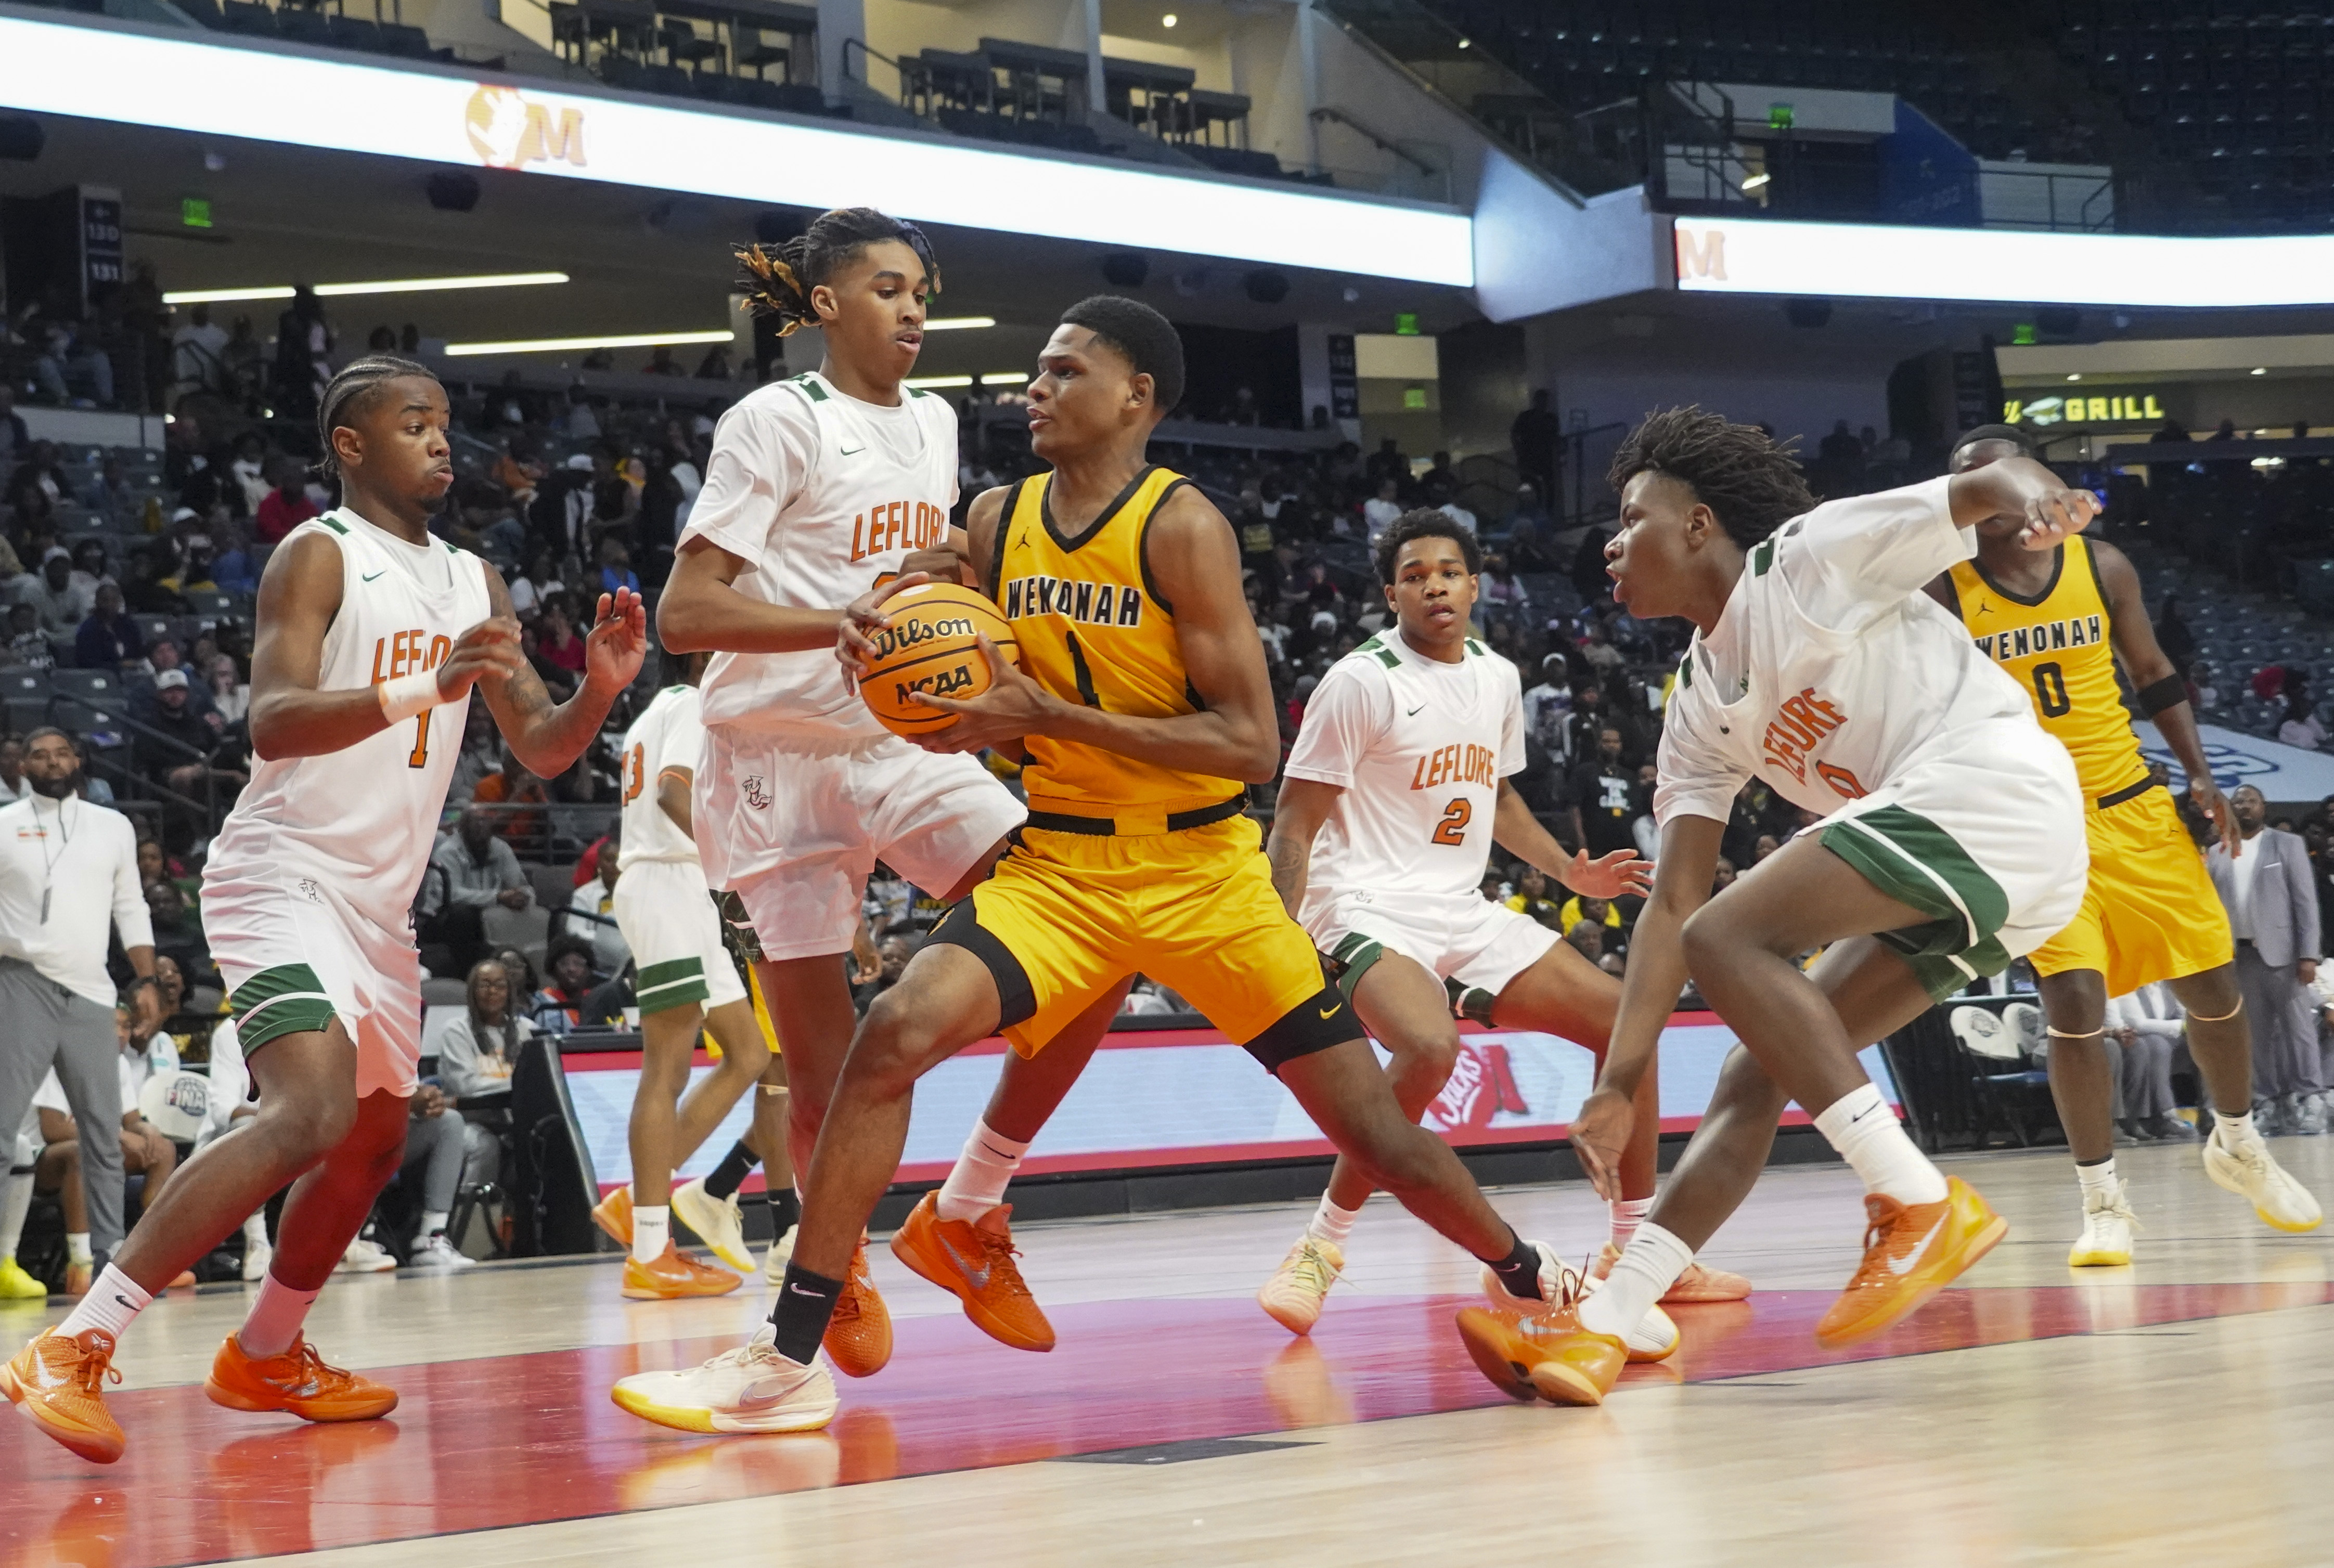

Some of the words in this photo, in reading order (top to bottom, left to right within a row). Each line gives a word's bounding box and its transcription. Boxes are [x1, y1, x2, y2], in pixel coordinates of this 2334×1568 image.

[2065, 394, 2164, 422] GRILL
[850, 500, 945, 563] LEFLOR
[871, 617, 977, 662] Wilson
[1974, 613, 2101, 662] WENONAH
[895, 664, 974, 705] NCAA
[1066, 630, 1101, 710] 1
[2032, 662, 2071, 718] 0
[408, 707, 433, 769] 1
[1410, 743, 1494, 791] LEFLORE
[1430, 797, 1472, 847] 2
[165, 1086, 208, 1107] FINA
